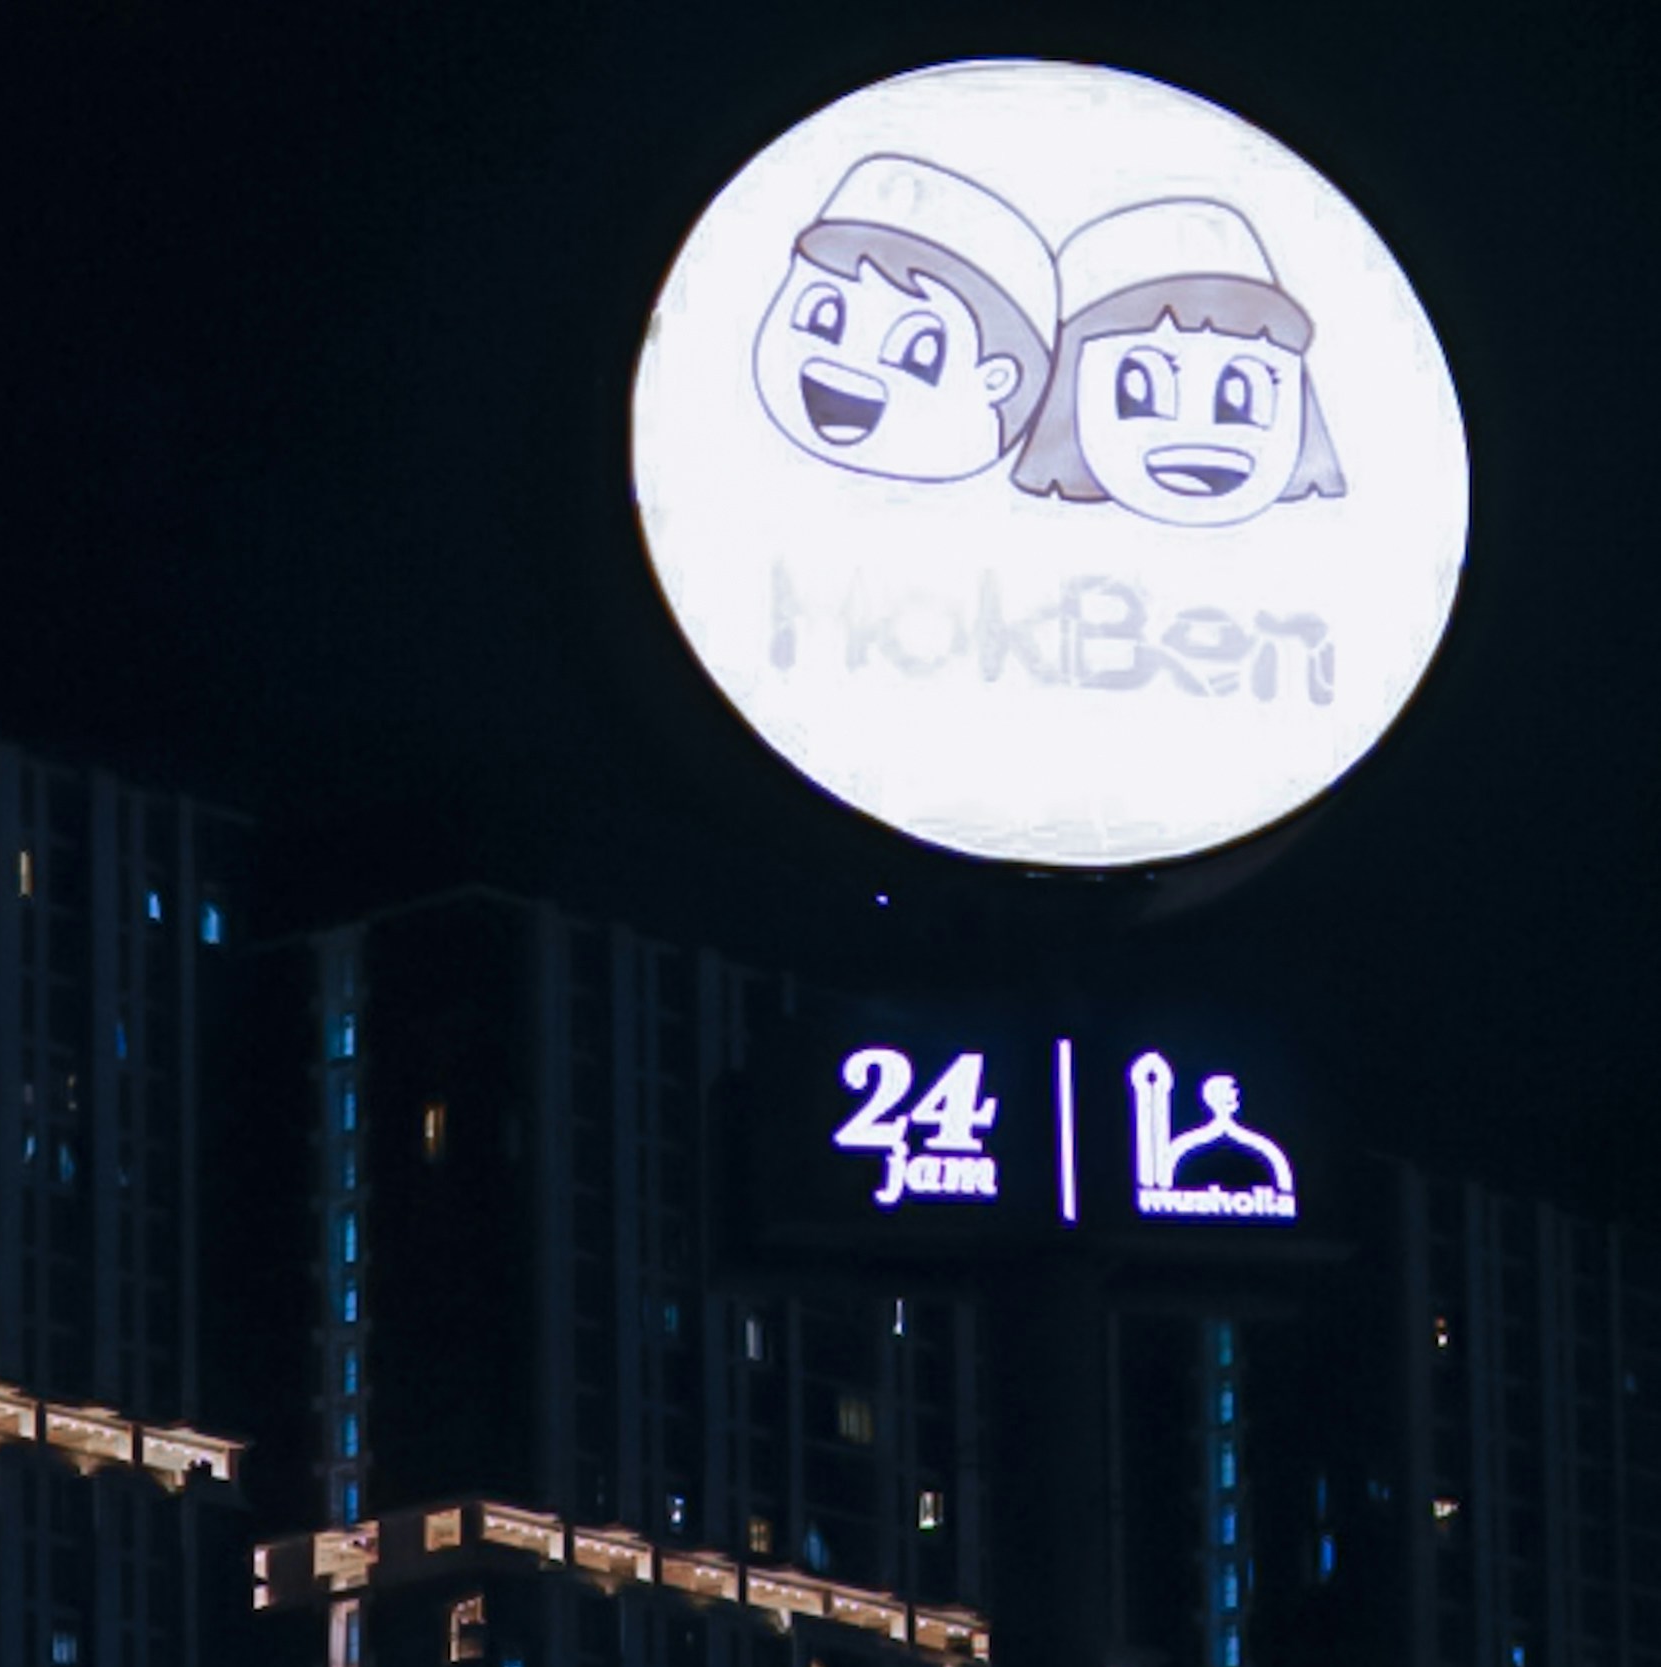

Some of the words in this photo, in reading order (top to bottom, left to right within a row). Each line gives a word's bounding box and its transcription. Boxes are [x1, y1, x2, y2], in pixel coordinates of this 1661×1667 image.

[768, 553, 1336, 706] HokBen
[833, 1047, 999, 1153] 24
[875, 1142, 999, 1204] jam
